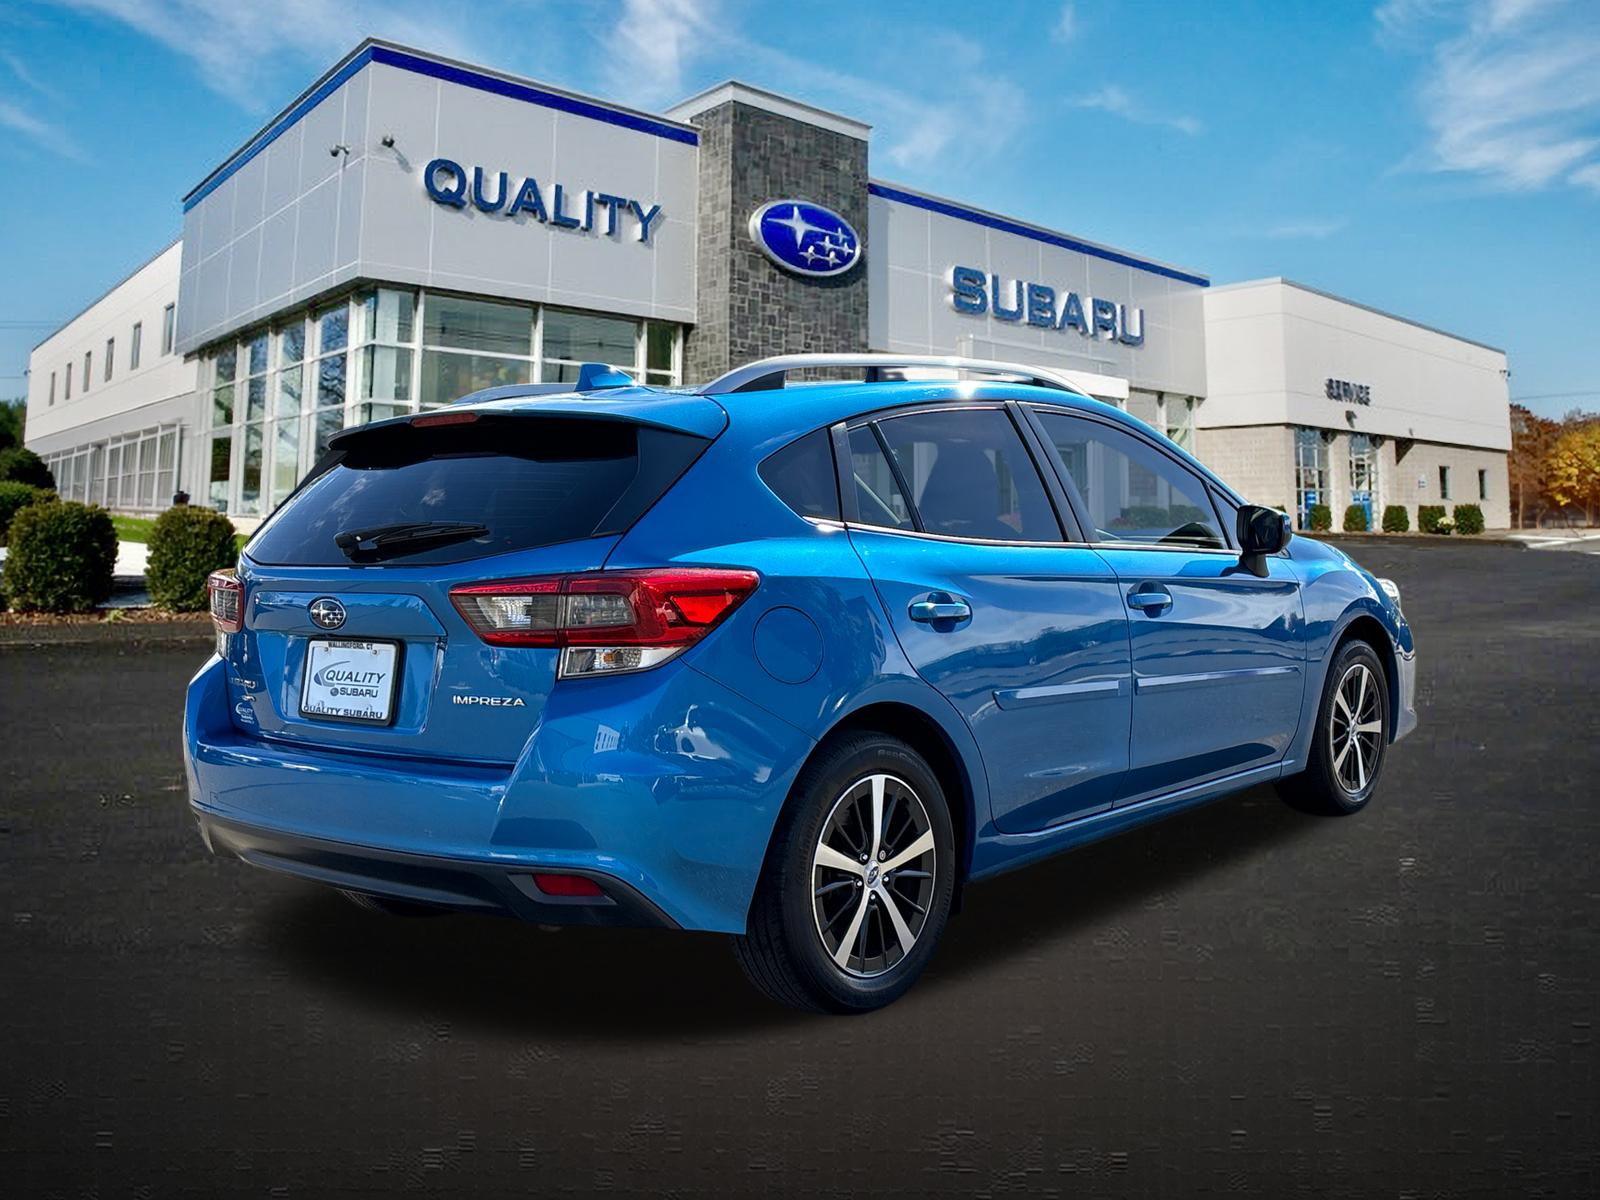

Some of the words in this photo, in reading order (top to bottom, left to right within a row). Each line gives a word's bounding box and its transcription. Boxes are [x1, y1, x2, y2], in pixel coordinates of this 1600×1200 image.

[424, 158, 661, 243] QUALITY
[952, 265, 1145, 346] SUBARU
[1325, 378, 1370, 406] SERVICE
[325, 669, 386, 684] QUALITY
[339, 687, 379, 698] SUBARU
[452, 695, 525, 707] IMPREZA
[303, 705, 341, 715] QUALITY
[343, 708, 383, 719] SUBARU
